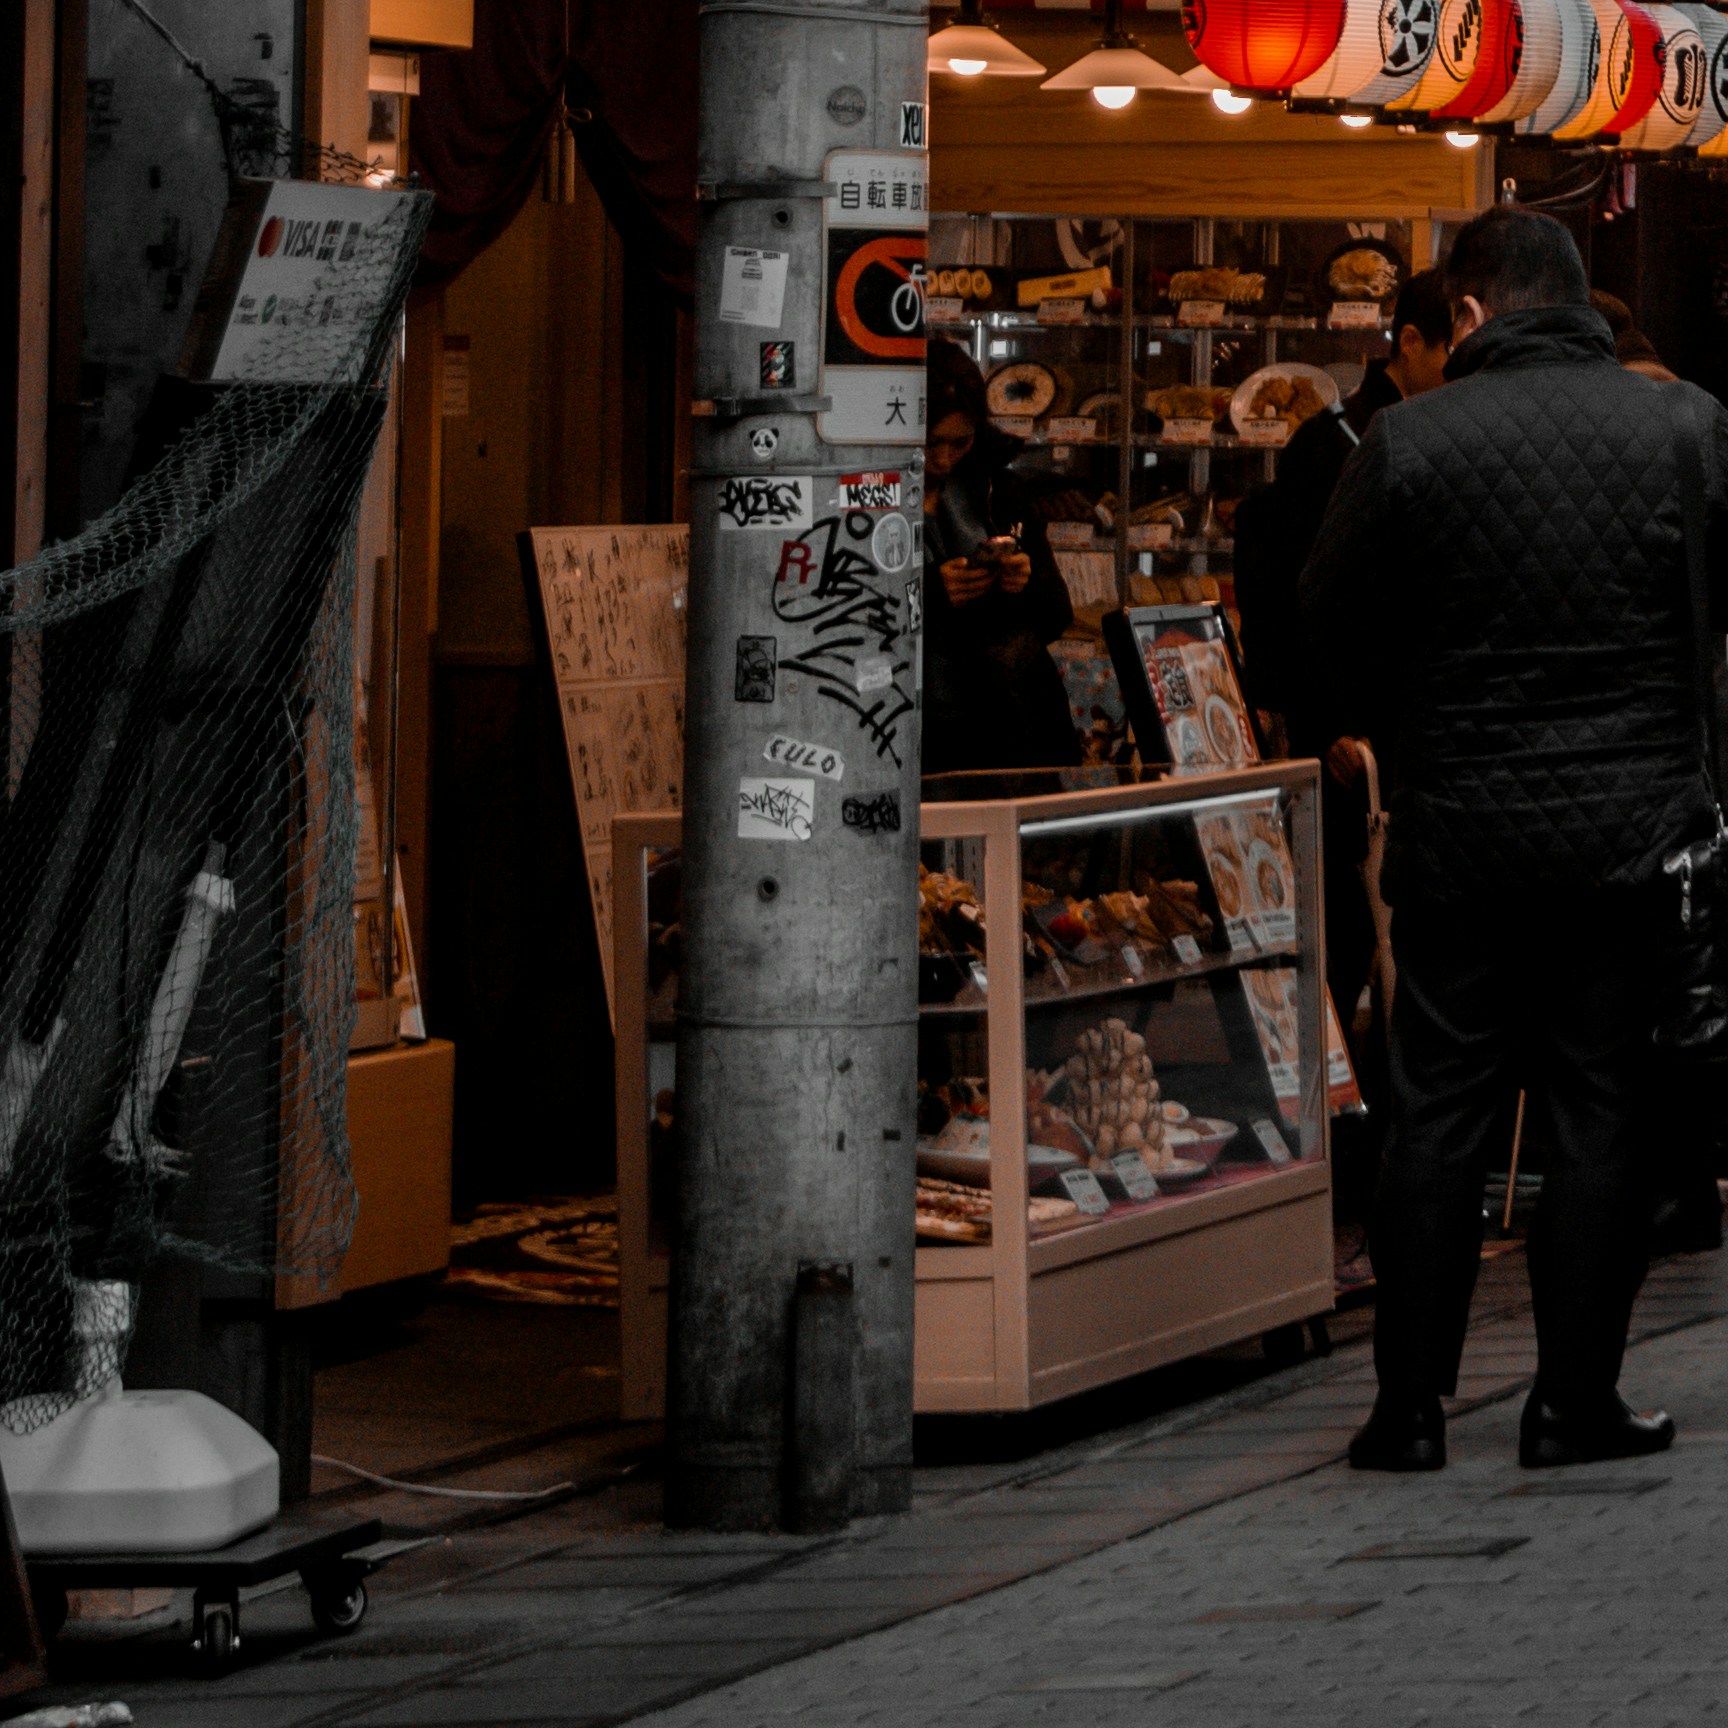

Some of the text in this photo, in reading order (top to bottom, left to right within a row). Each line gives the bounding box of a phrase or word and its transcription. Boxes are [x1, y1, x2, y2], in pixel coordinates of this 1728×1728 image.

[841, 180, 928, 211] 自転車放
[283, 219, 321, 257] VISA
